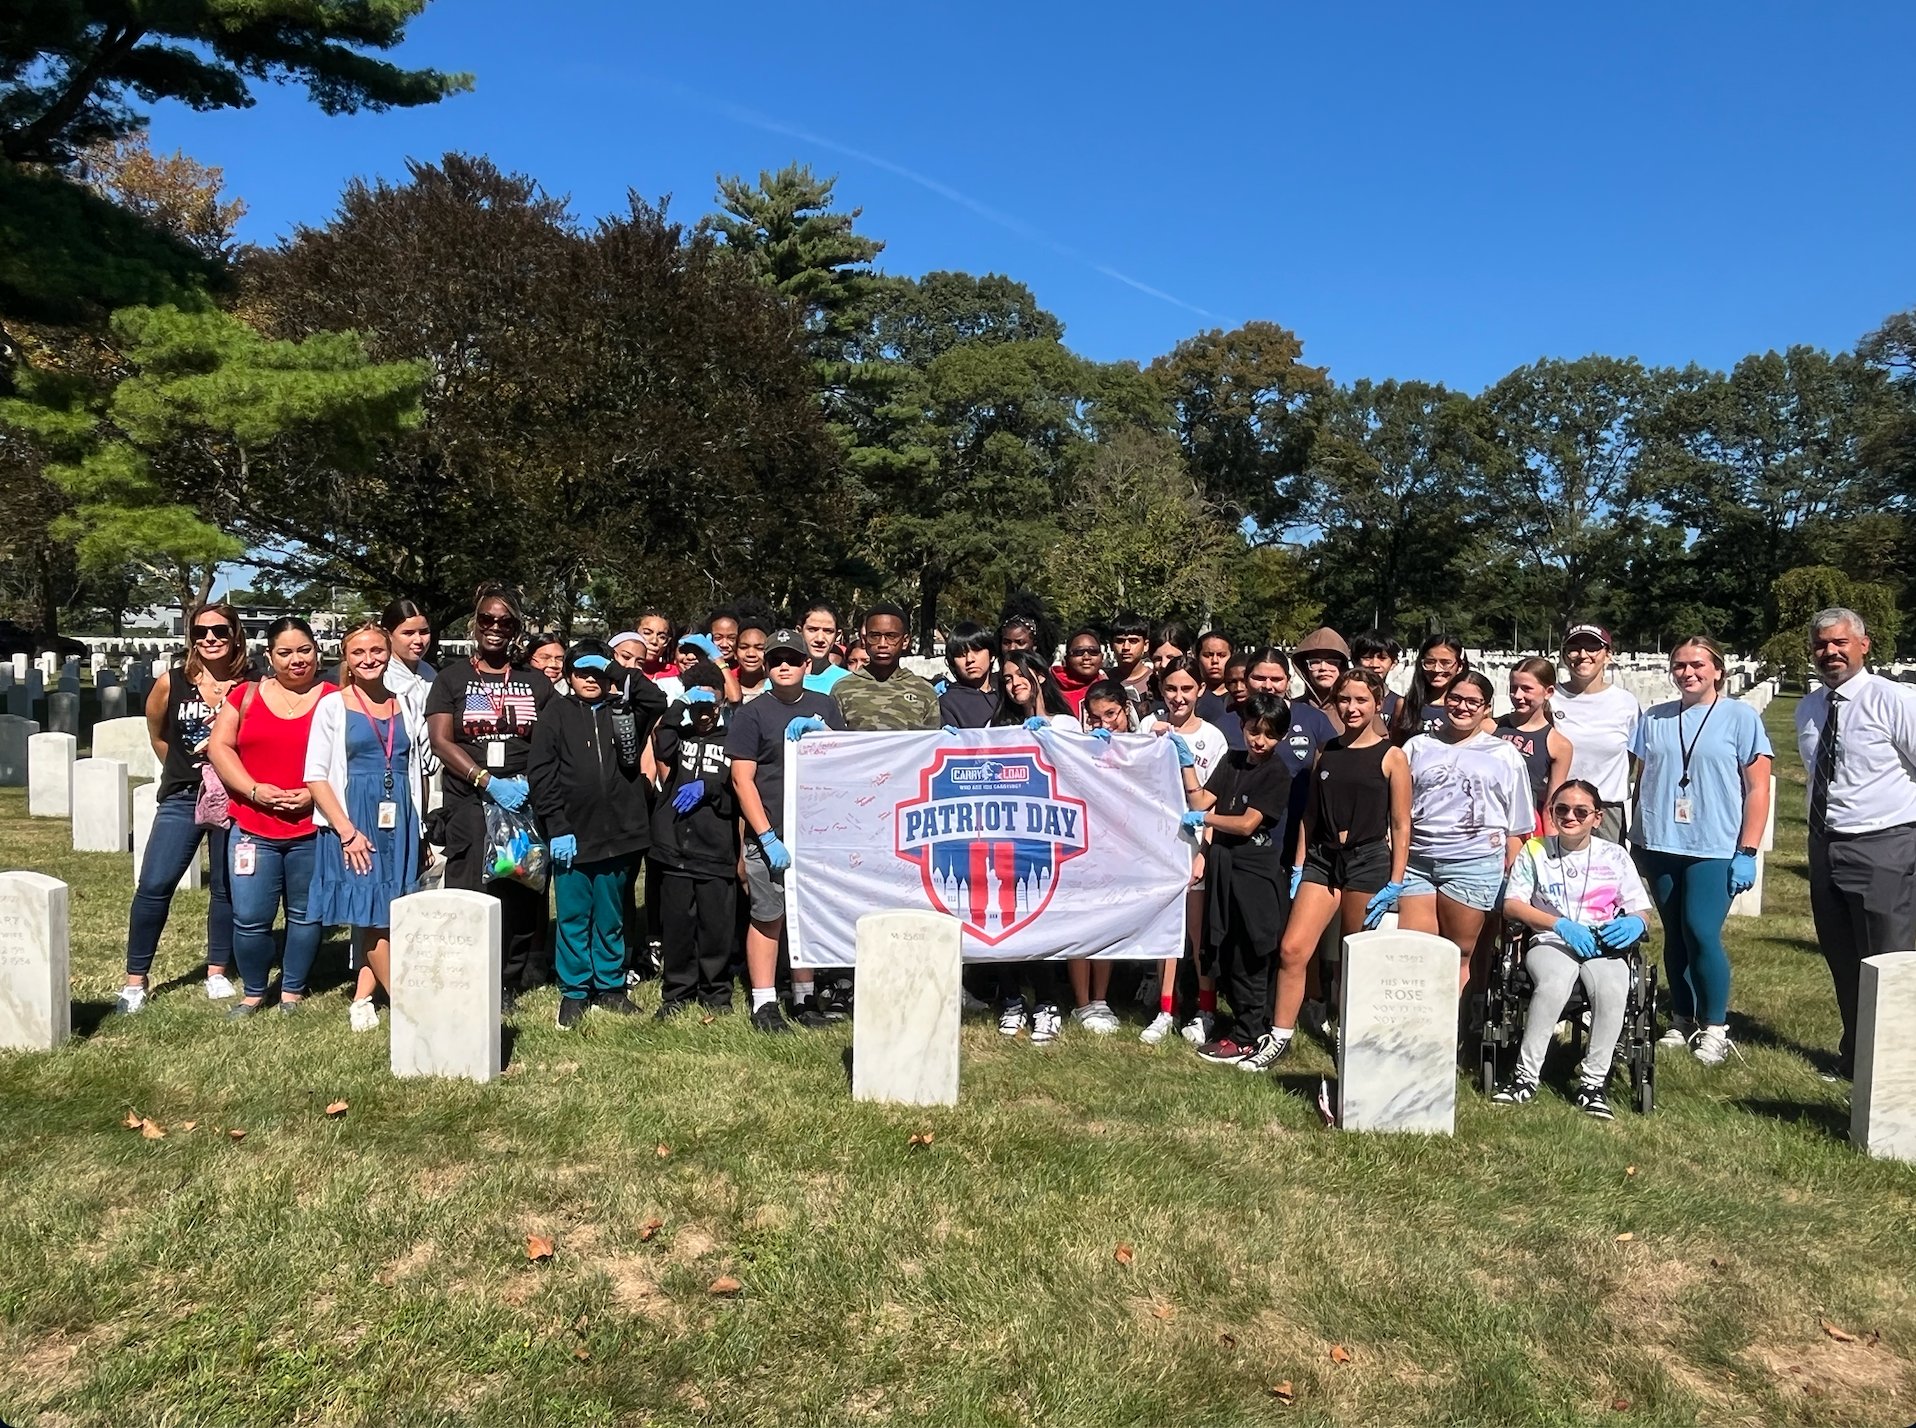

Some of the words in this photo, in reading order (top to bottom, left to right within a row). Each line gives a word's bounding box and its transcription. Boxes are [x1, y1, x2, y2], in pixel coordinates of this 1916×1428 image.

[953, 769, 982, 781] CARRY
[1003, 768, 1026, 780] LOAD
[906, 801, 1018, 842] PATRIOT
[1026, 802, 1077, 839] DAY
[1381, 978, 1398, 987] HIS
[1402, 978, 1425, 987] WIFE
[1384, 989, 1424, 1001] ROSE
